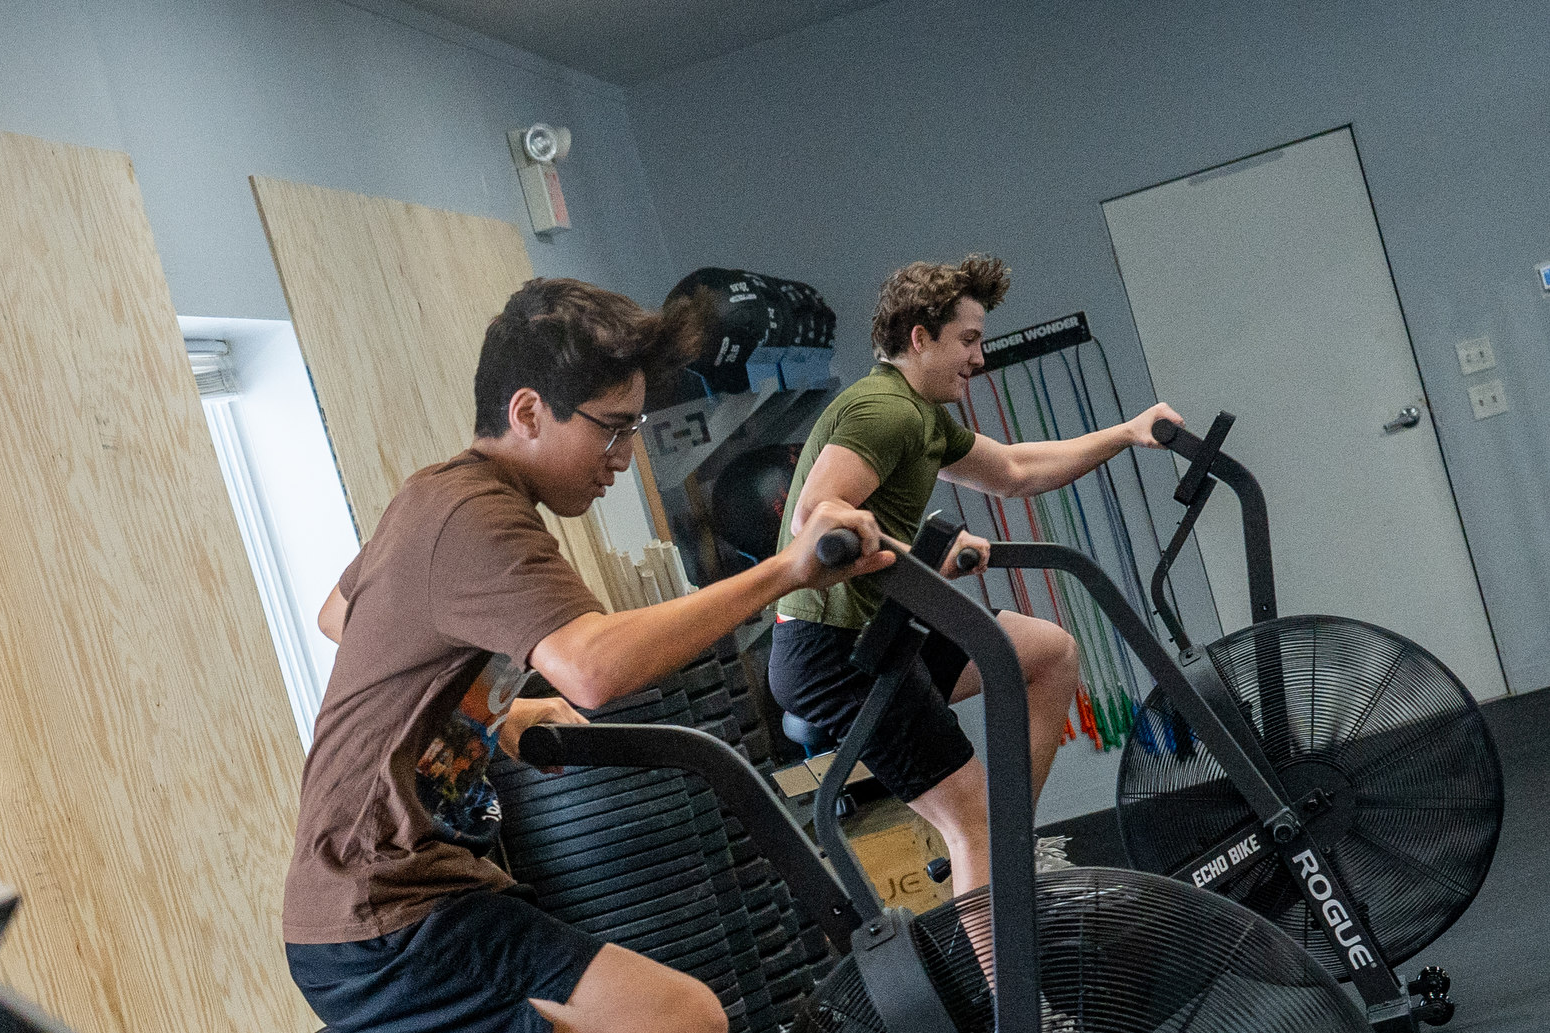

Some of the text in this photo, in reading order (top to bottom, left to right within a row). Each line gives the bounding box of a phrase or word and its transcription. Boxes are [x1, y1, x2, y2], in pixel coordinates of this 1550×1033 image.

[1024, 316, 1079, 341] WONDER
[1192, 833, 1261, 888] ECHO BIKE
[1292, 849, 1374, 970] ROGUE
